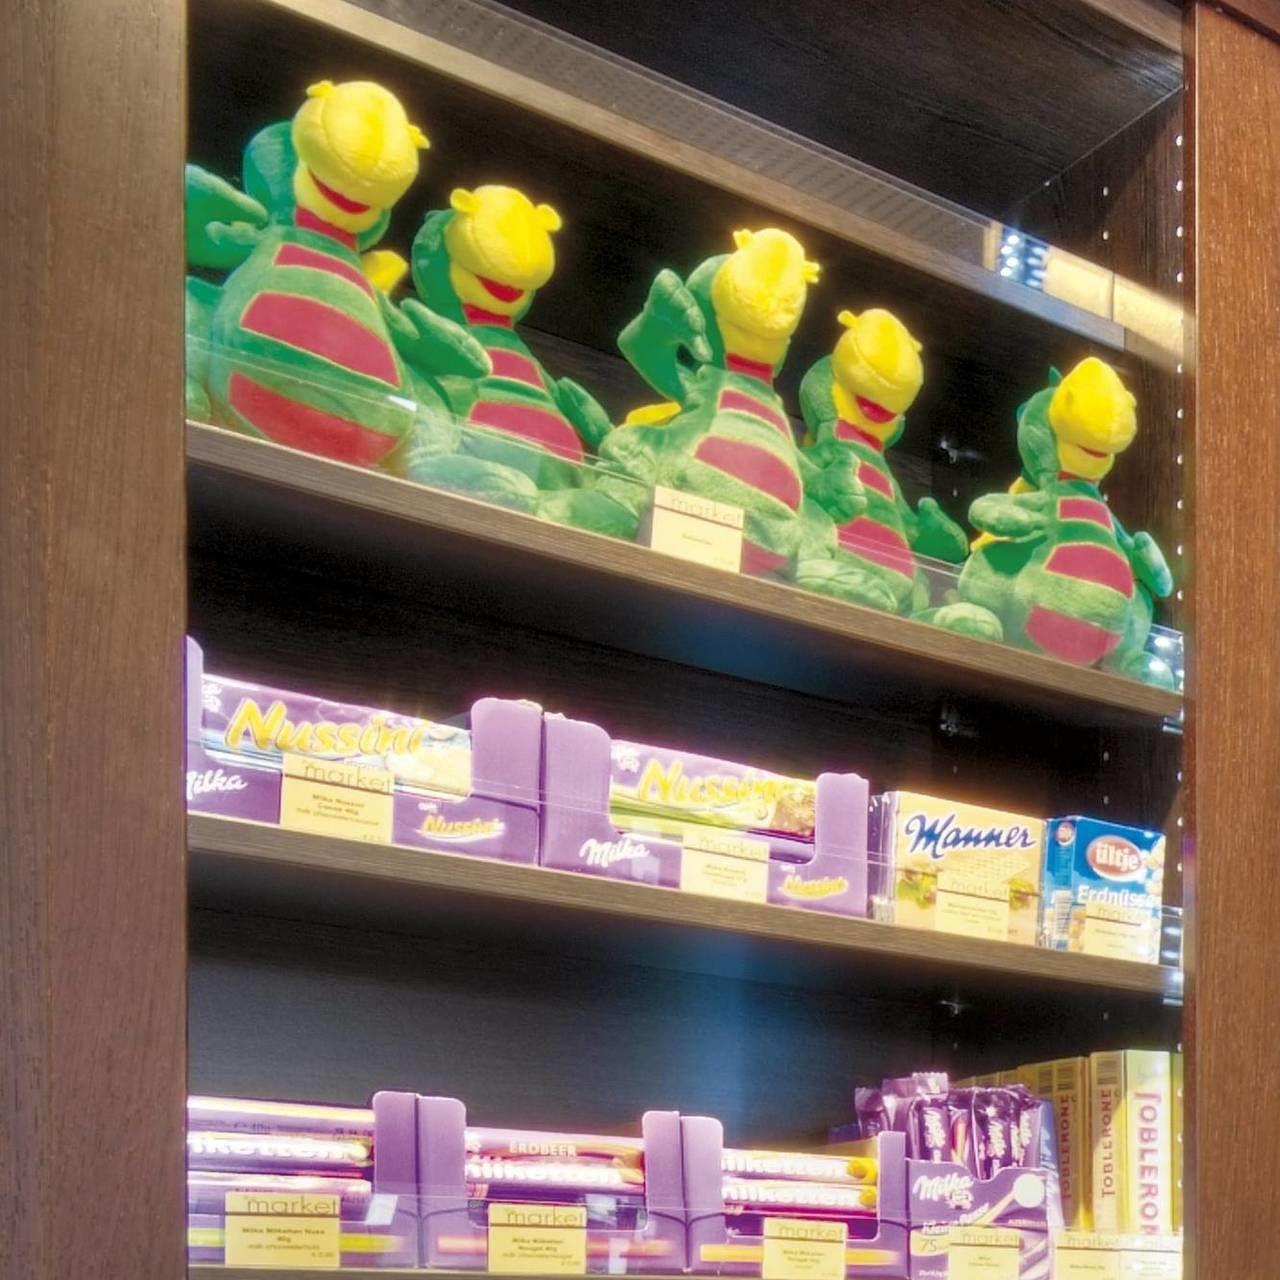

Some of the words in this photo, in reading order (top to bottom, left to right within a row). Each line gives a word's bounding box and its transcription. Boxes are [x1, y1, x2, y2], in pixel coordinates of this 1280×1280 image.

[225, 697, 428, 755] Nussini
[304, 763, 391, 792] market
[904, 814, 1036, 861] Manner
[579, 838, 650, 868] Milka
[1094, 842, 1141, 871] ültje
[1101, 1088, 1115, 1198] TOBLERONE
[1135, 1091, 1162, 1236] TOBLERON
[913, 1172, 974, 1201] Milka
[246, 1195, 337, 1214] market
[506, 1207, 583, 1226] market
